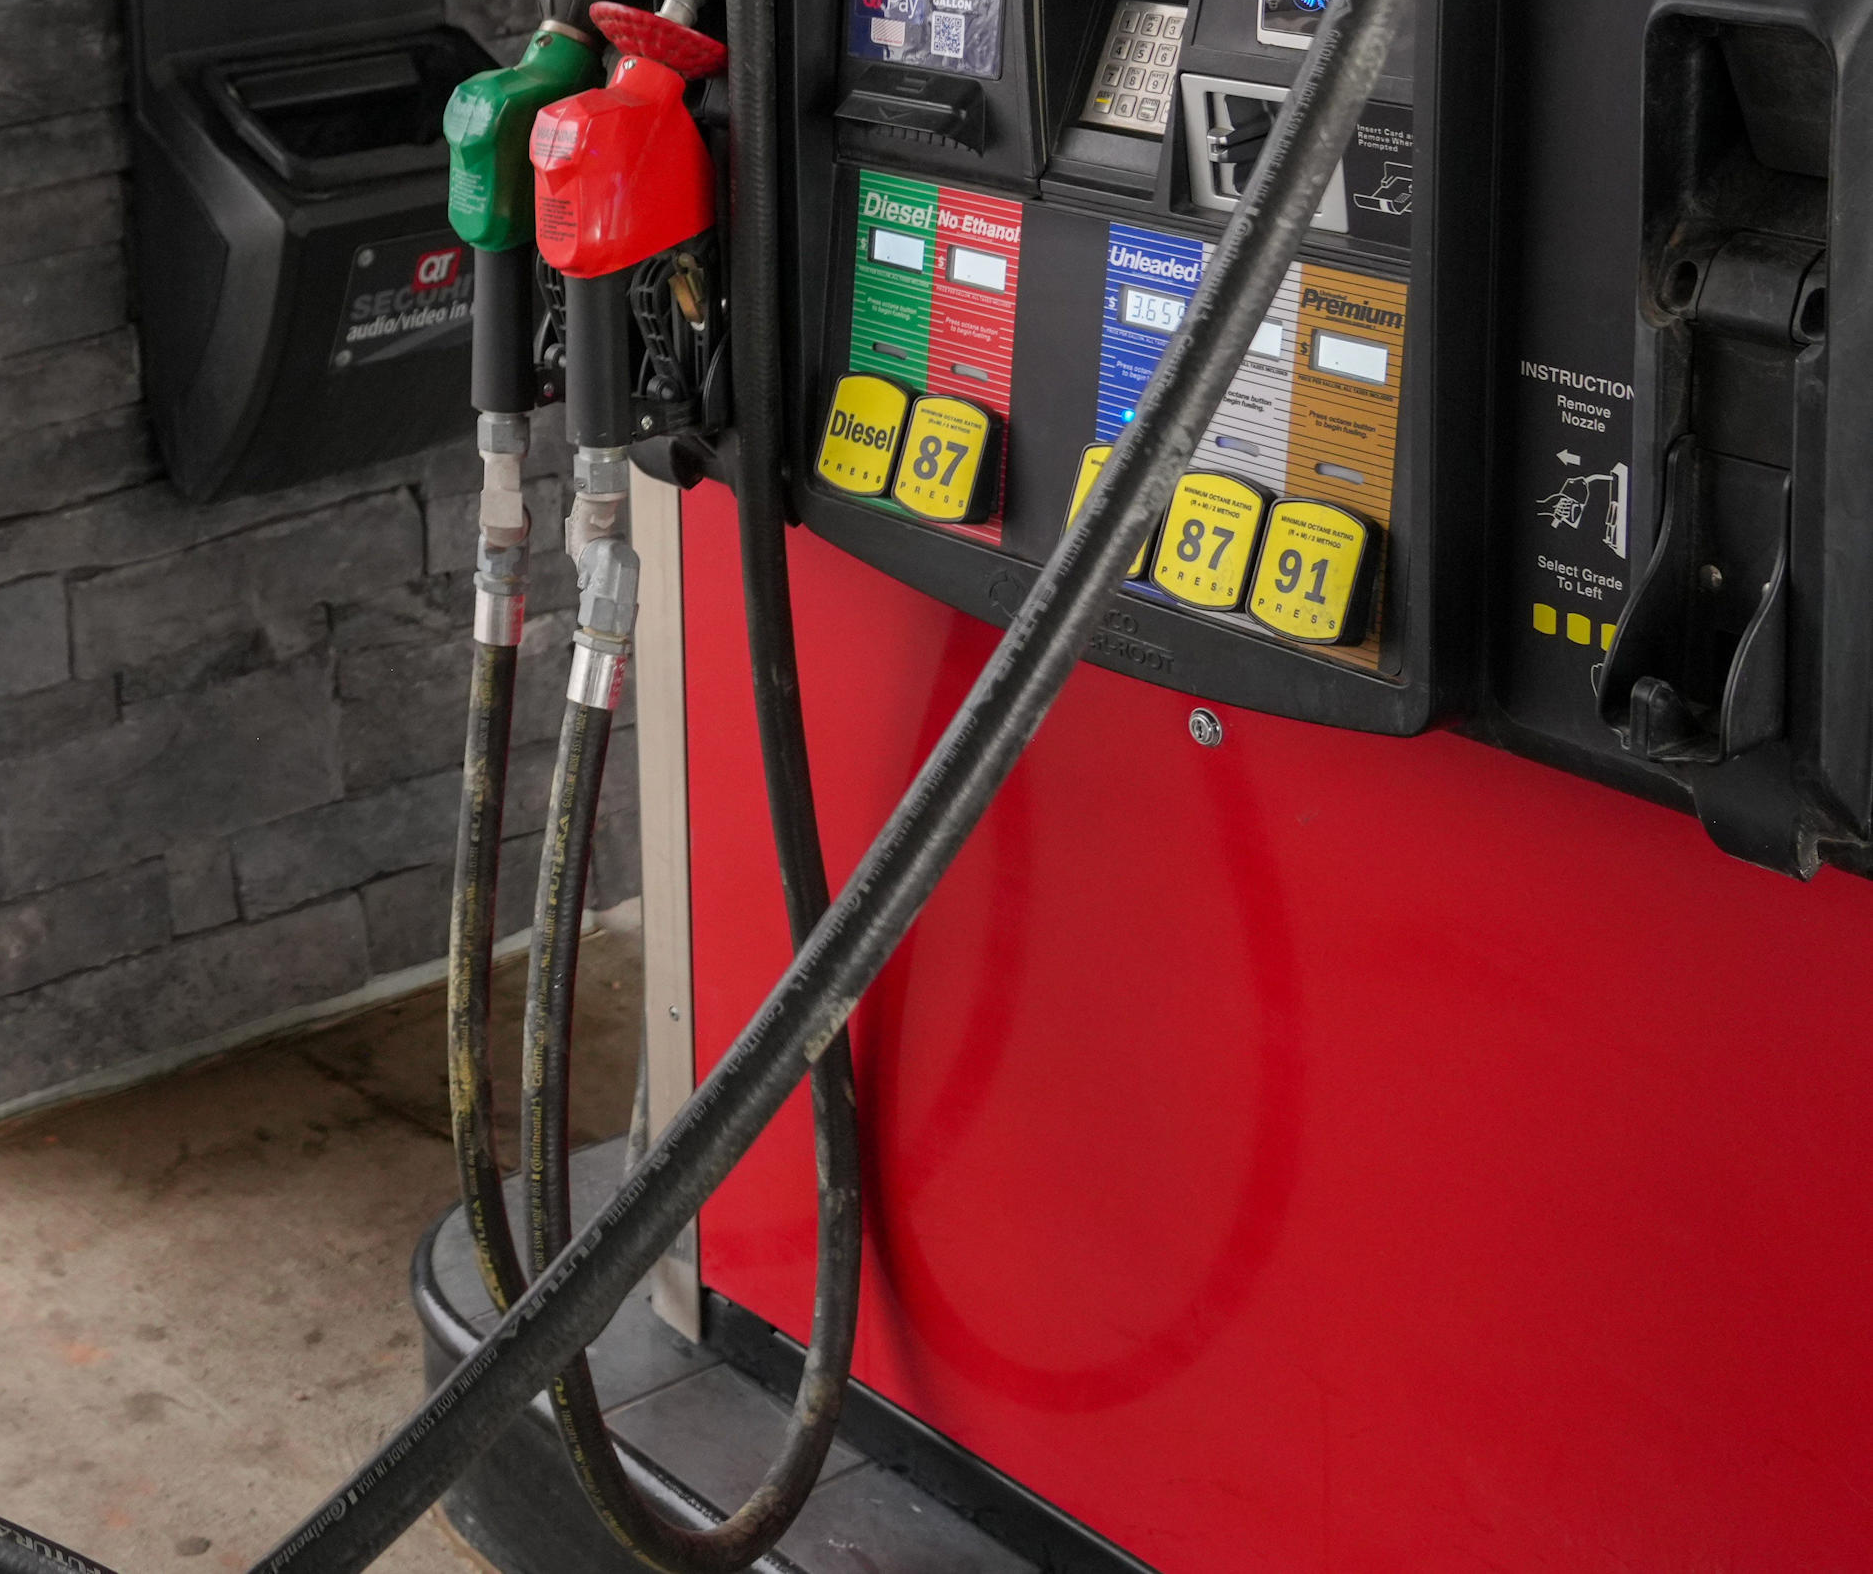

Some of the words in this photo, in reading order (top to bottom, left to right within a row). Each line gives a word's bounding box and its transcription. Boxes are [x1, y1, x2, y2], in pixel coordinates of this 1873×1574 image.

[1357, 124, 1382, 135] Insert
[1383, 128, 1404, 139] Card
[1357, 131, 1390, 144] Remove
[1358, 139, 1399, 152] Prompted
[862, 191, 933, 228] Diesel
[936, 209, 958, 229] No
[961, 215, 1021, 243] Ethanol
[1109, 245, 1199, 283] Unleaded
[346, 306, 448, 342] audio/video
[449, 299, 468, 320] in
[1301, 287, 1403, 330] Premium
[1521, 360, 1635, 400] INSTRUCTION
[1308, 410, 1328, 422] Press
[1557, 394, 1612, 419] Remove
[1561, 410, 1606, 433] Nozzle
[830, 409, 897, 453] Diesel
[912, 435, 969, 487] 87
[1176, 518, 1235, 571] 87
[1274, 548, 1329, 605] 91
[1537, 555, 1578, 578] Select
[1582, 567, 1624, 591] Grade
[1556, 576, 1574, 591] To
[1576, 580, 1604, 600] Left
